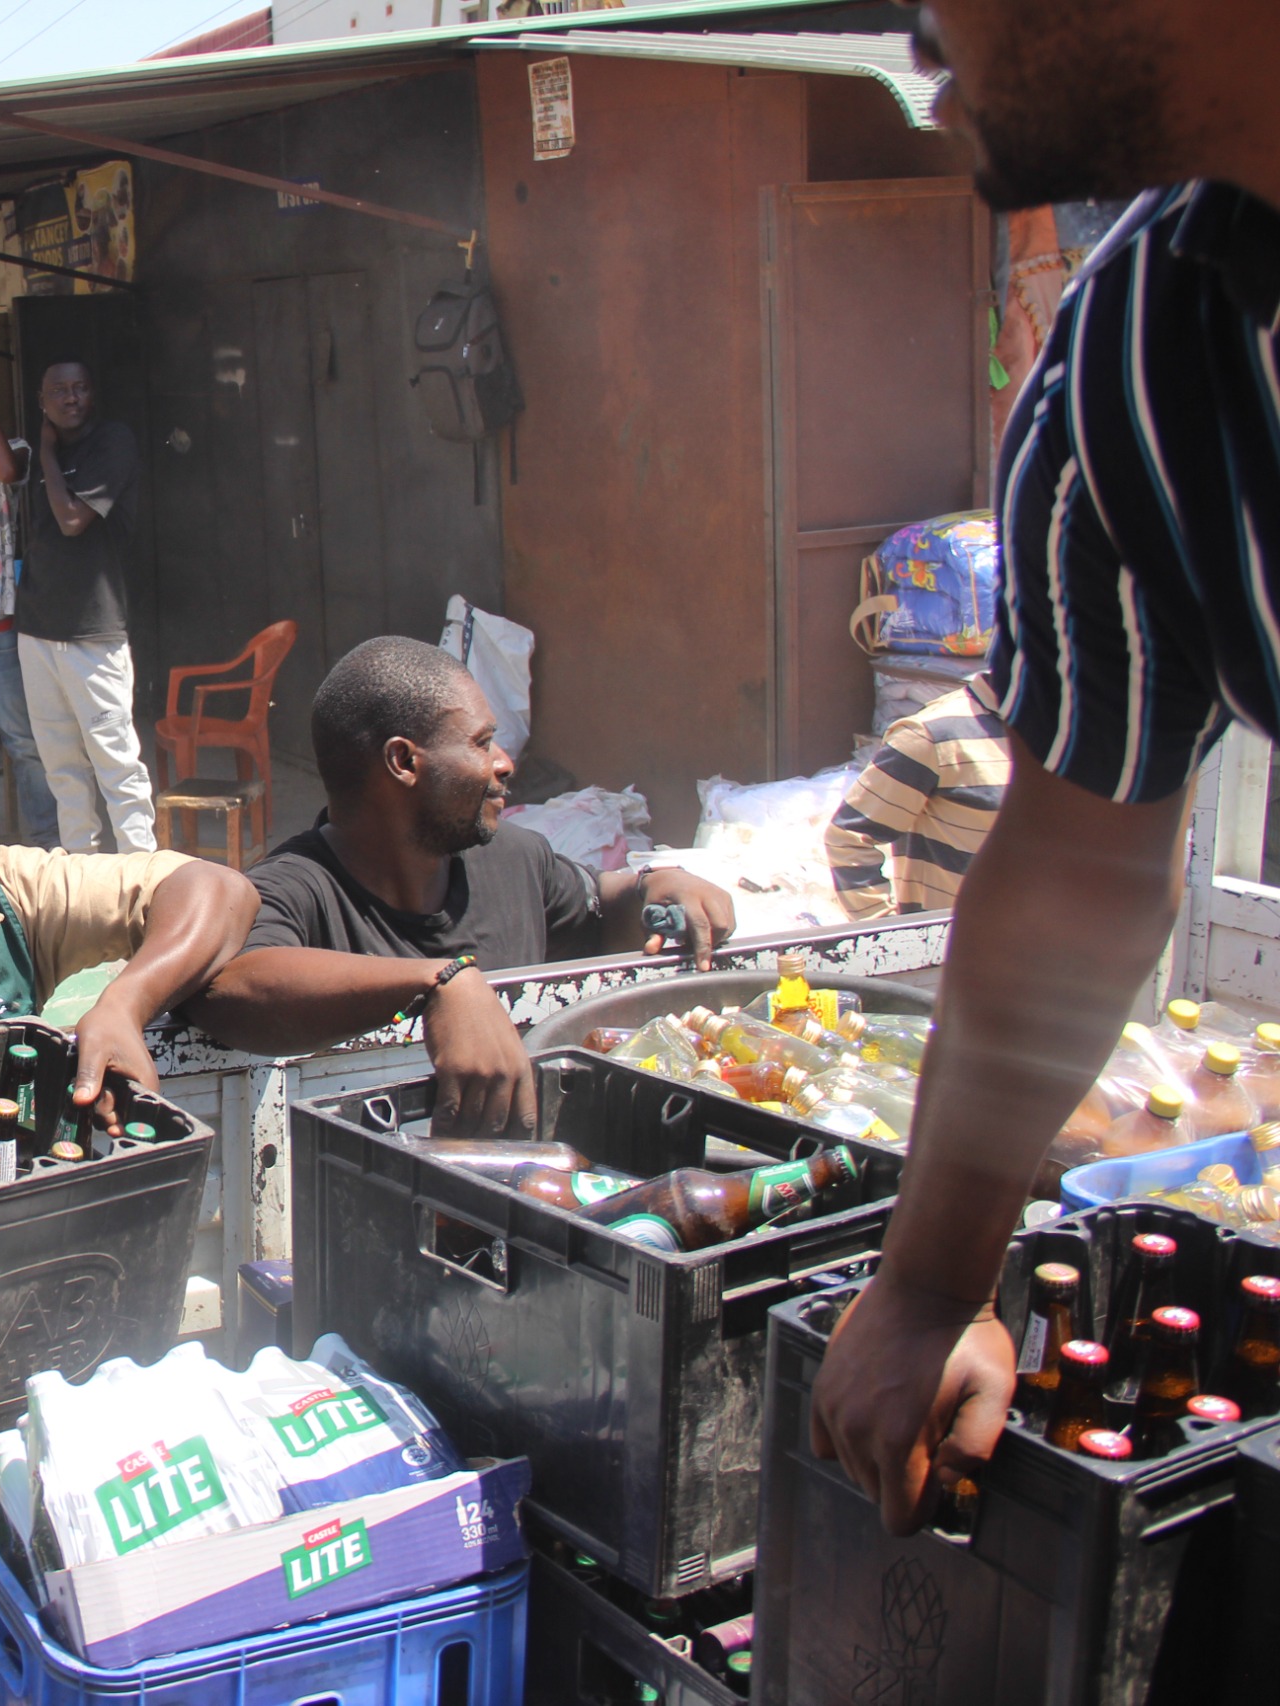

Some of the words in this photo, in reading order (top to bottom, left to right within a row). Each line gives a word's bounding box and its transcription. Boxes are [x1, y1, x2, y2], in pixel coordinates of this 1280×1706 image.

[294, 1390, 331, 1411] CASTLE
[282, 1396, 377, 1452] LITE
[109, 1454, 213, 1543] LITE
[467, 1500, 494, 1524] 24
[307, 1525, 338, 1544] CASTLE
[461, 1523, 486, 1541] 330
[487, 1524, 498, 1535] ml
[290, 1532, 364, 1592] LITE
